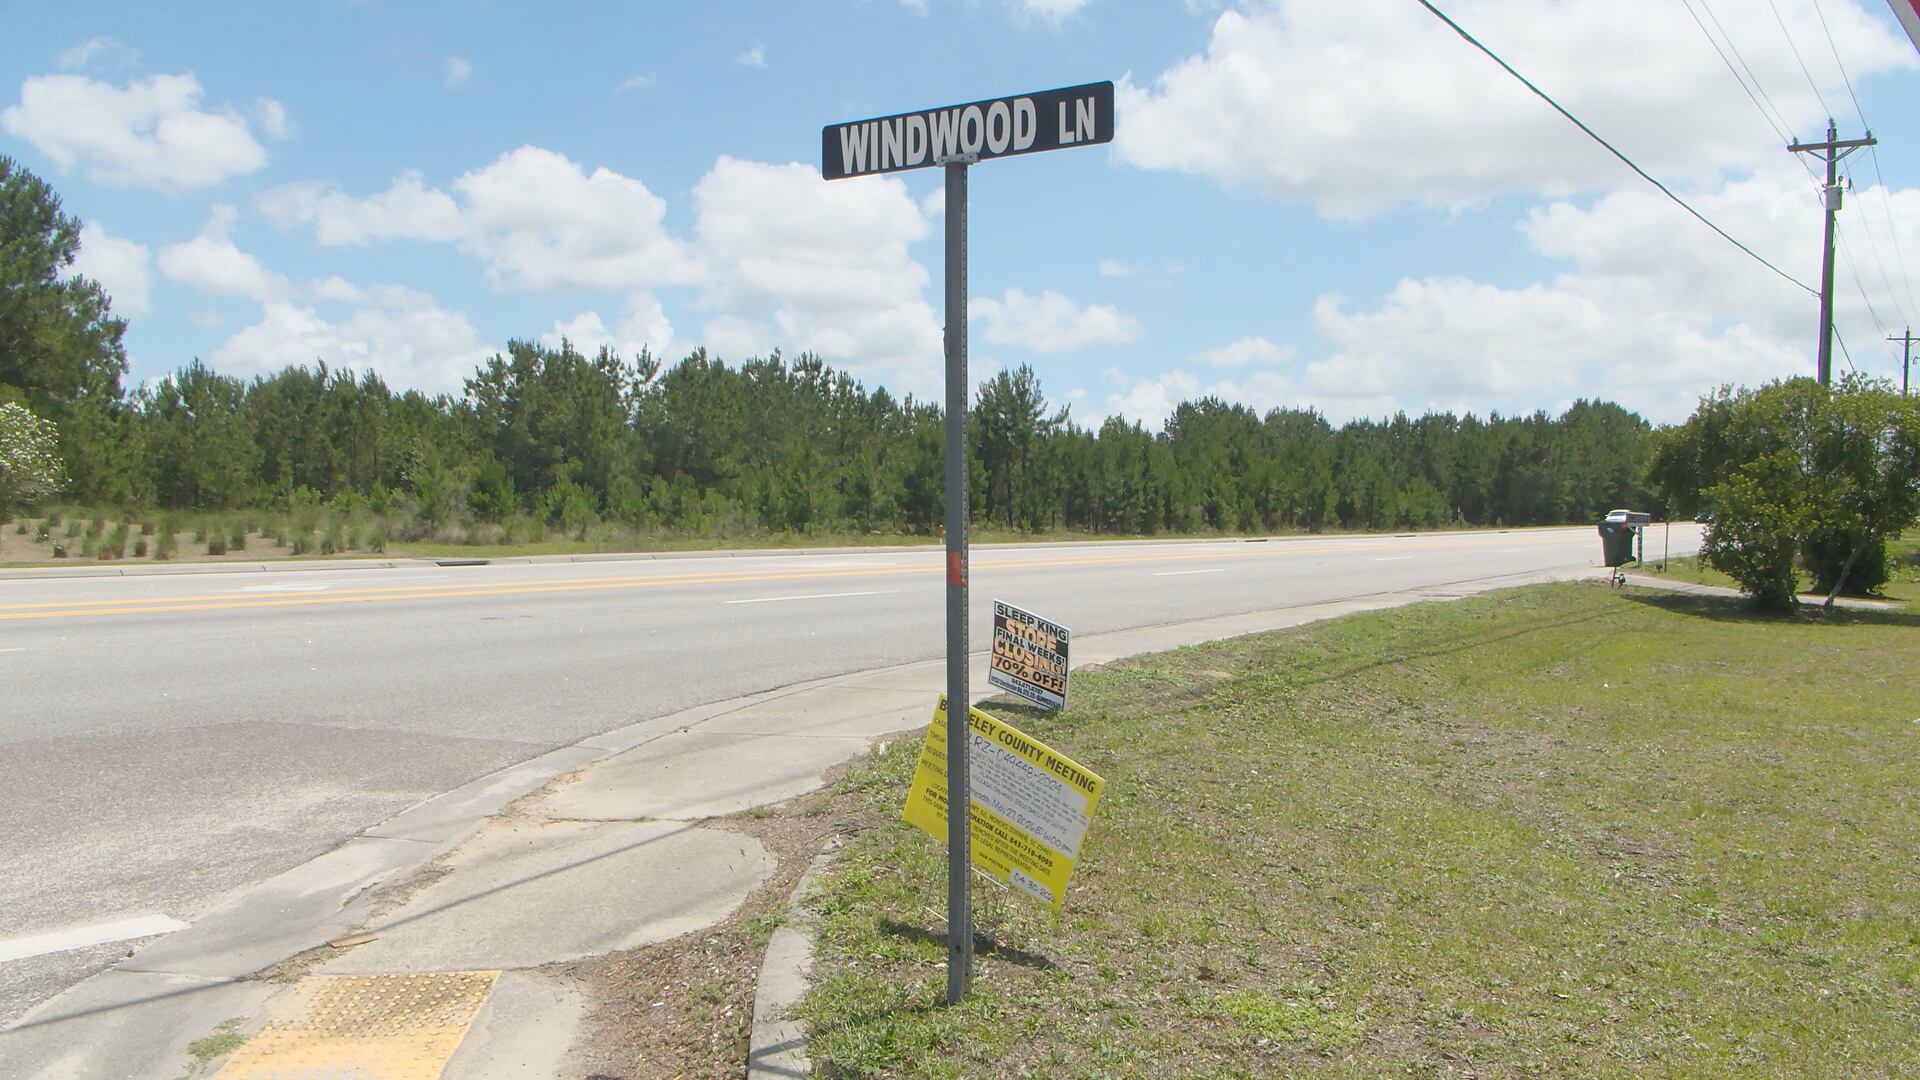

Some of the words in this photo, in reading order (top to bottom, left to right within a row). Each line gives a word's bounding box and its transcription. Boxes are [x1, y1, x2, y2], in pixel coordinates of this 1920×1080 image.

[839, 97, 1037, 175] WINDWOOD
[1058, 96, 1096, 145] LN
[997, 604, 1034, 628] SLEEP
[1038, 621, 1067, 641] KING
[1006, 618, 1057, 652] STORE
[997, 628, 1025, 648] FINAL
[1028, 643, 1065, 667] WEEKS!
[995, 656, 1029, 679] 70%
[1033, 670, 1064, 692] OFF!
[921, 759, 947, 778] MEETING
[999, 731, 1043, 763] COUNTY
[1045, 757, 1097, 793] MEETING
[926, 787, 937, 799] FOR
[994, 828, 1009, 841] CALL
[972, 825, 995, 843] REMOVED
[995, 838, 1009, 851] AFTER
[1019, 853, 1039, 869] MEETING
[980, 837, 994, 850] LEGAL
